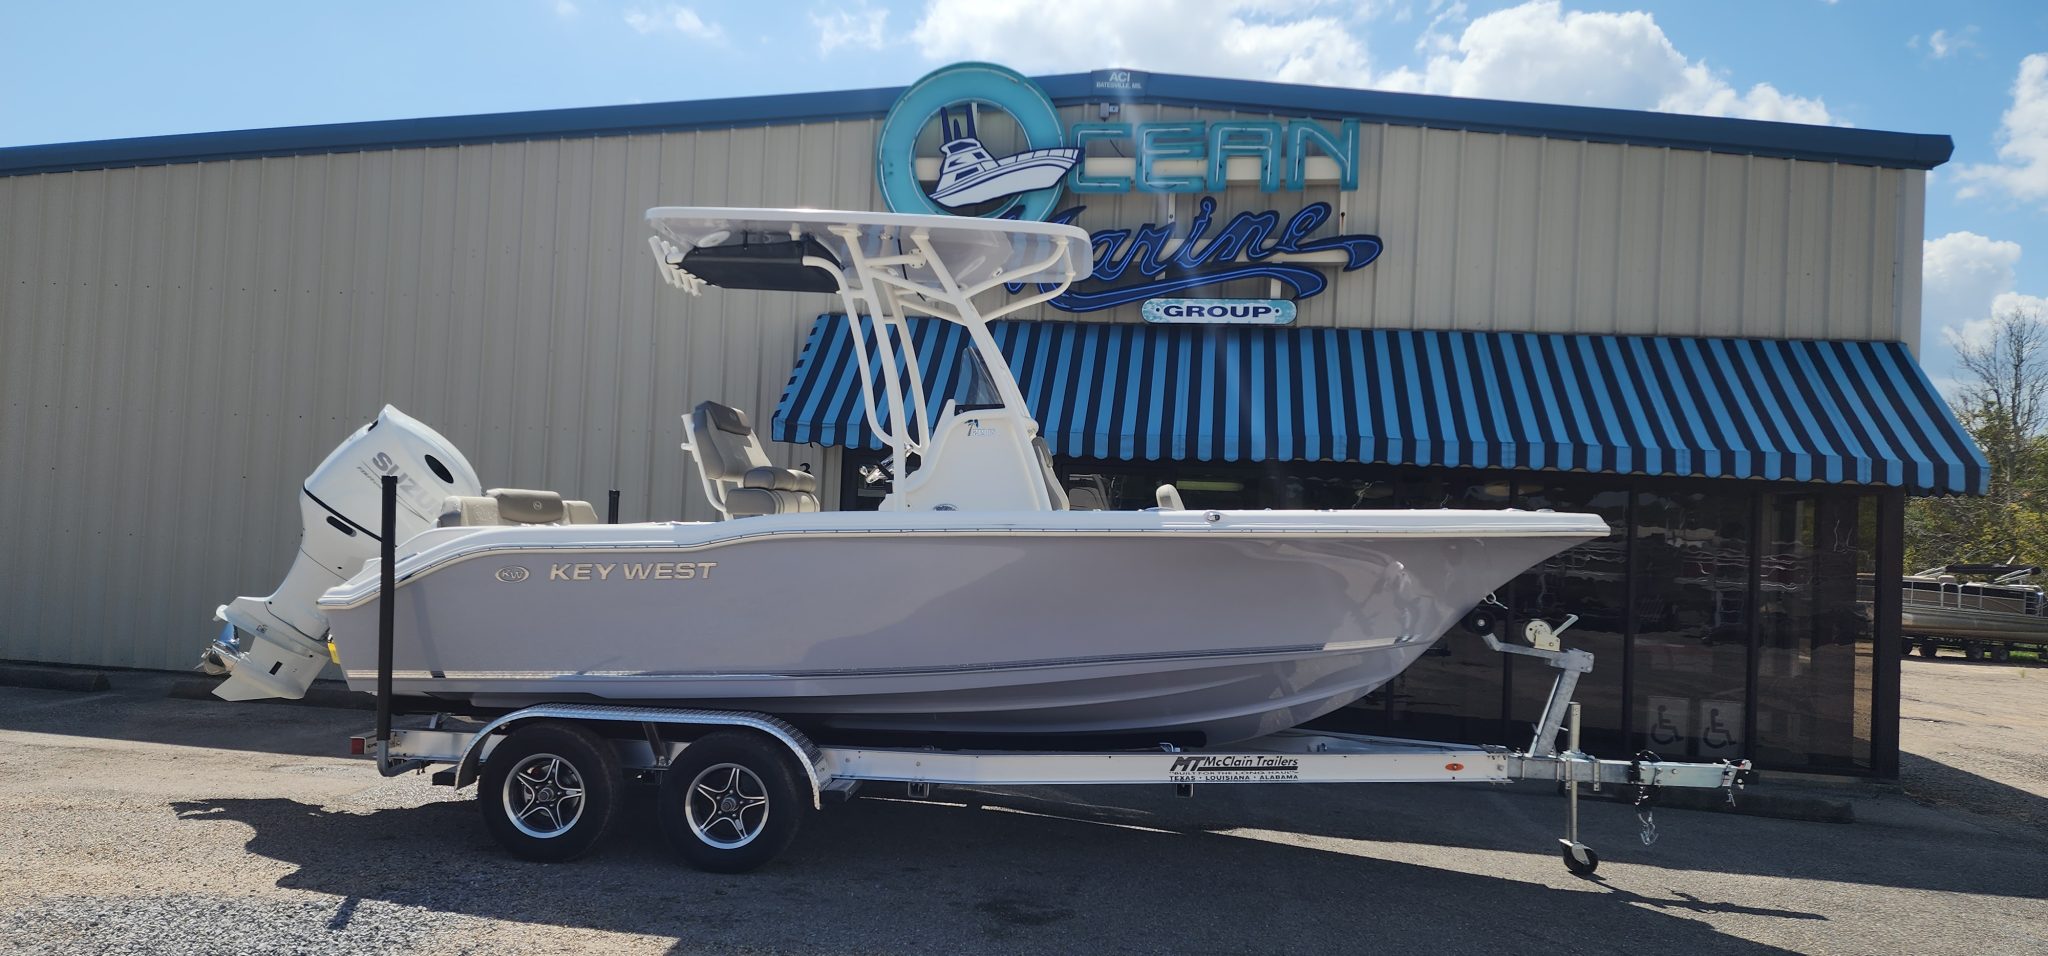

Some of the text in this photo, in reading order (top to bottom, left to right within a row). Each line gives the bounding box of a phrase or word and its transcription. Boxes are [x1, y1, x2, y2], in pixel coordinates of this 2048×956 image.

[1109, 72, 1130, 82] ACI
[1163, 305, 1272, 318] GROUP
[550, 562, 717, 581] KEY WEST
[1170, 756, 1298, 772] MT McClain Trailers
